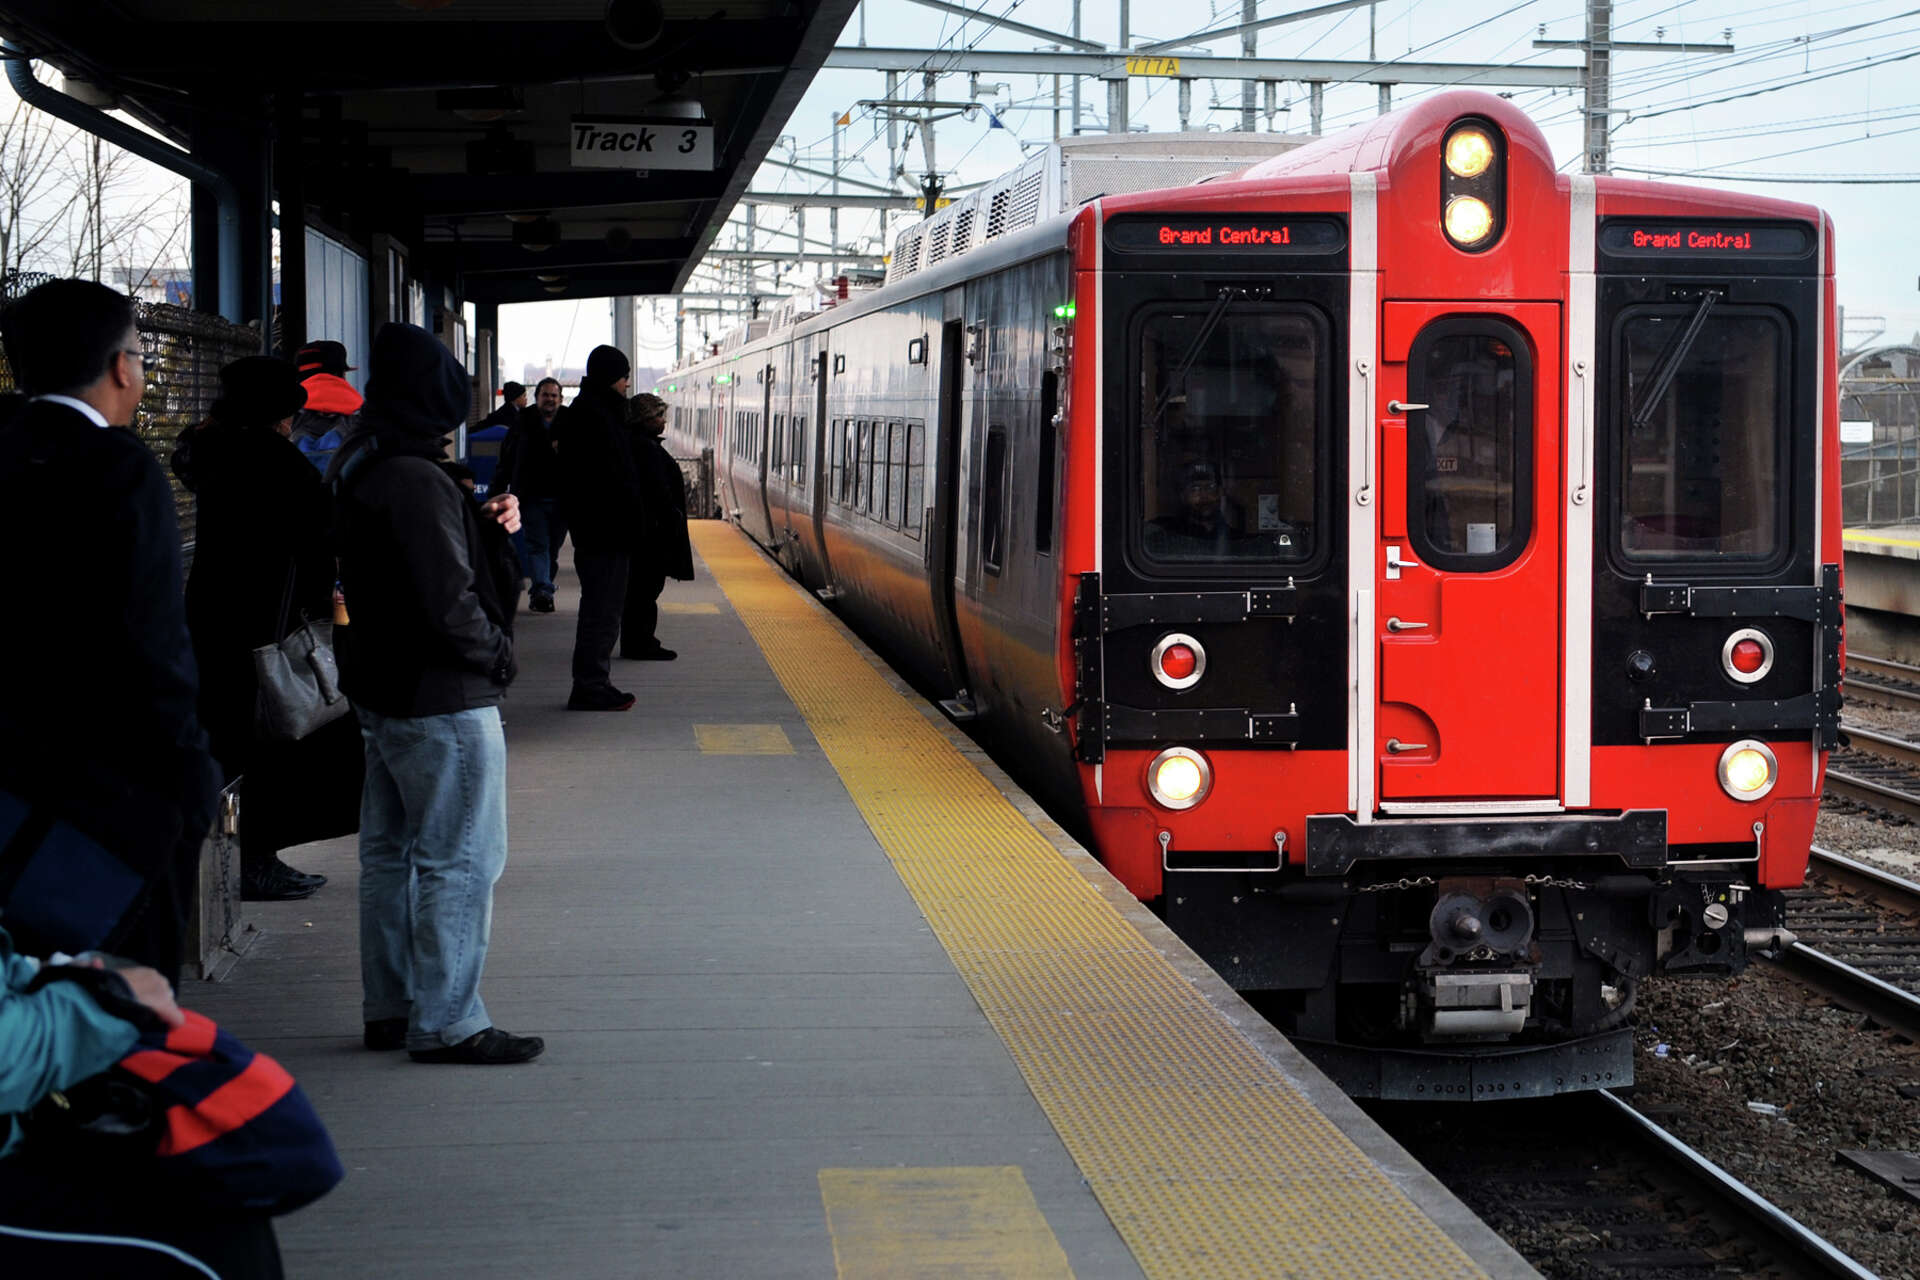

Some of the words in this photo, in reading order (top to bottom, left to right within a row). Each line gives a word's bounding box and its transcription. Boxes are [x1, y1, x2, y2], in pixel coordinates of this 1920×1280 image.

[1127, 58, 1177, 74] 777A
[574, 125, 656, 152] Track
[678, 129, 698, 153] 3
[1159, 226, 1212, 244] Grand
[1219, 226, 1290, 244] Central
[1633, 230, 1681, 248] Grand
[1688, 231, 1751, 249] Central
